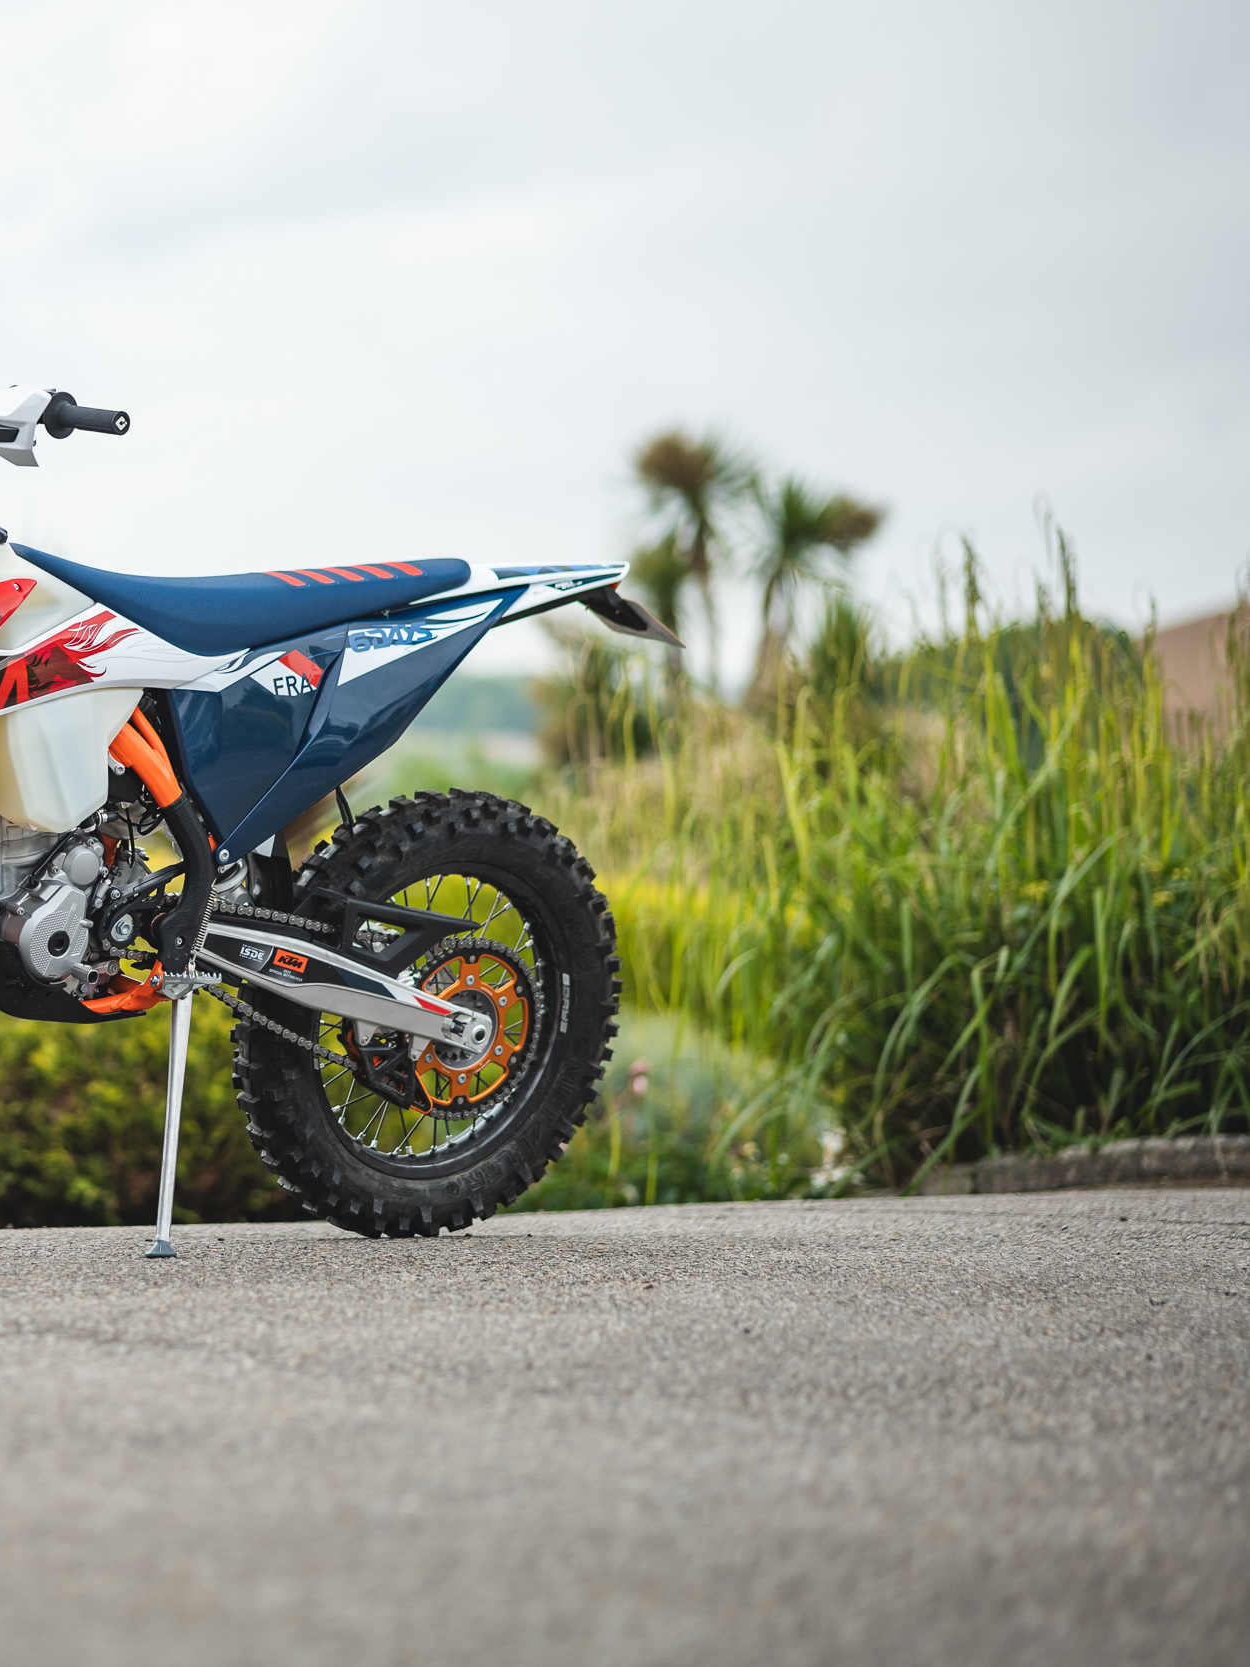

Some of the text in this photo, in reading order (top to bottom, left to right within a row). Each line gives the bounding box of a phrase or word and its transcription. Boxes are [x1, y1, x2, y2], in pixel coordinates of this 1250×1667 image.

[348, 621, 433, 653] 6DAYS
[273, 672, 314, 697] FRA
[240, 946, 265, 961] ISDE
[277, 954, 304, 969] KTM
